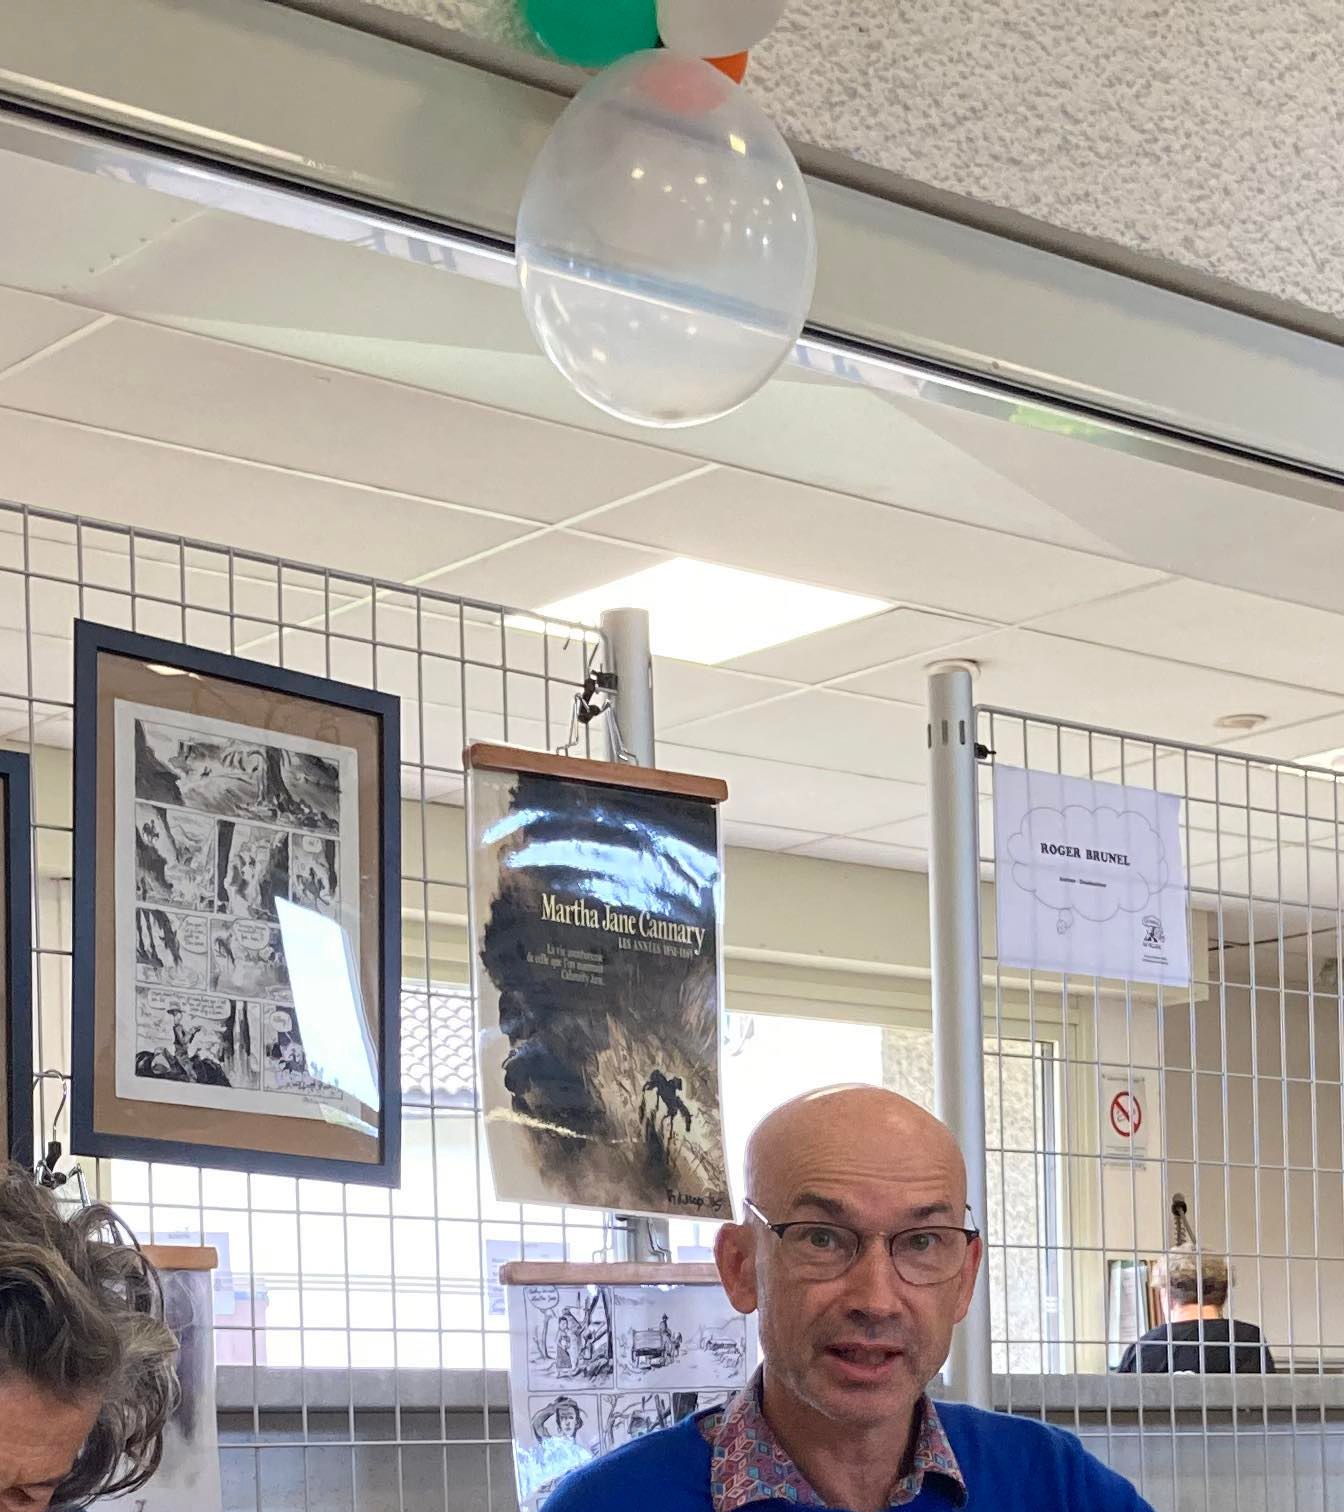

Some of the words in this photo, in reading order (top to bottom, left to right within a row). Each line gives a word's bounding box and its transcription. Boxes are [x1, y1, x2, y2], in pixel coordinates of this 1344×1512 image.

[1040, 842, 1082, 859] ROGER
[1085, 848, 1131, 867] BRUNEL
[541, 893, 600, 929] Martha
[602, 904, 637, 936] Jane
[639, 910, 706, 955] Cannary
